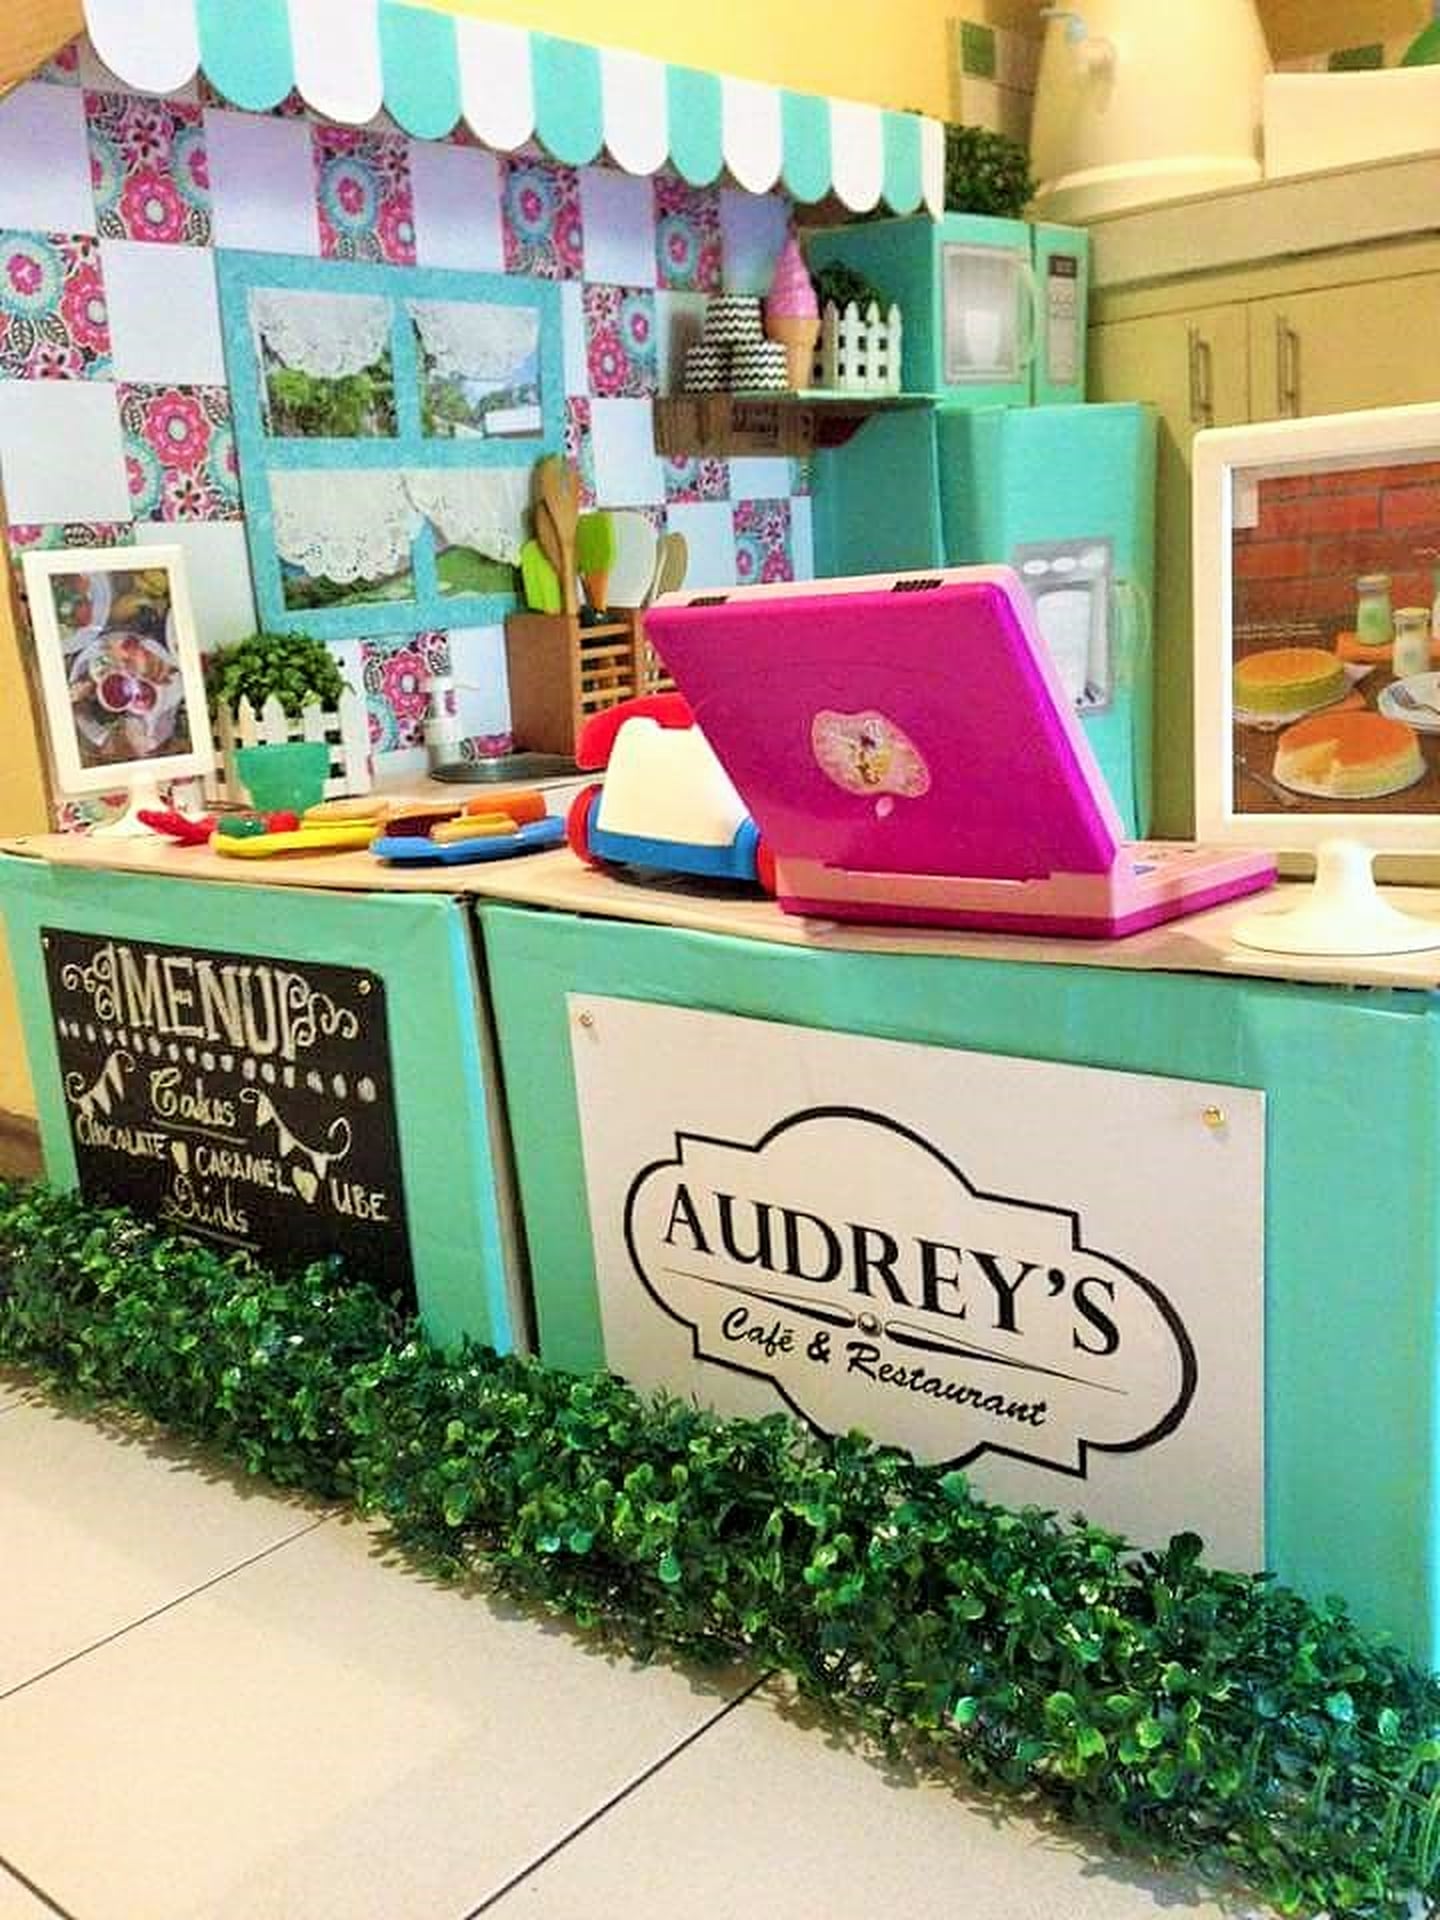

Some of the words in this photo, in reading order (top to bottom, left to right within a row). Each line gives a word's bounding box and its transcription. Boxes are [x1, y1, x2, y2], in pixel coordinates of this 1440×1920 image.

[116, 946, 277, 1056] MENU
[158, 1173, 249, 1234] Drinks
[194, 1145, 297, 1197] CARAMEL
[330, 1178, 389, 1222] UBE
[662, 1182, 1121, 1356] AUDREY'S
[721, 1306, 795, 1357] Café
[806, 1331, 831, 1365] &
[845, 1340, 1048, 1427] Restaurant
